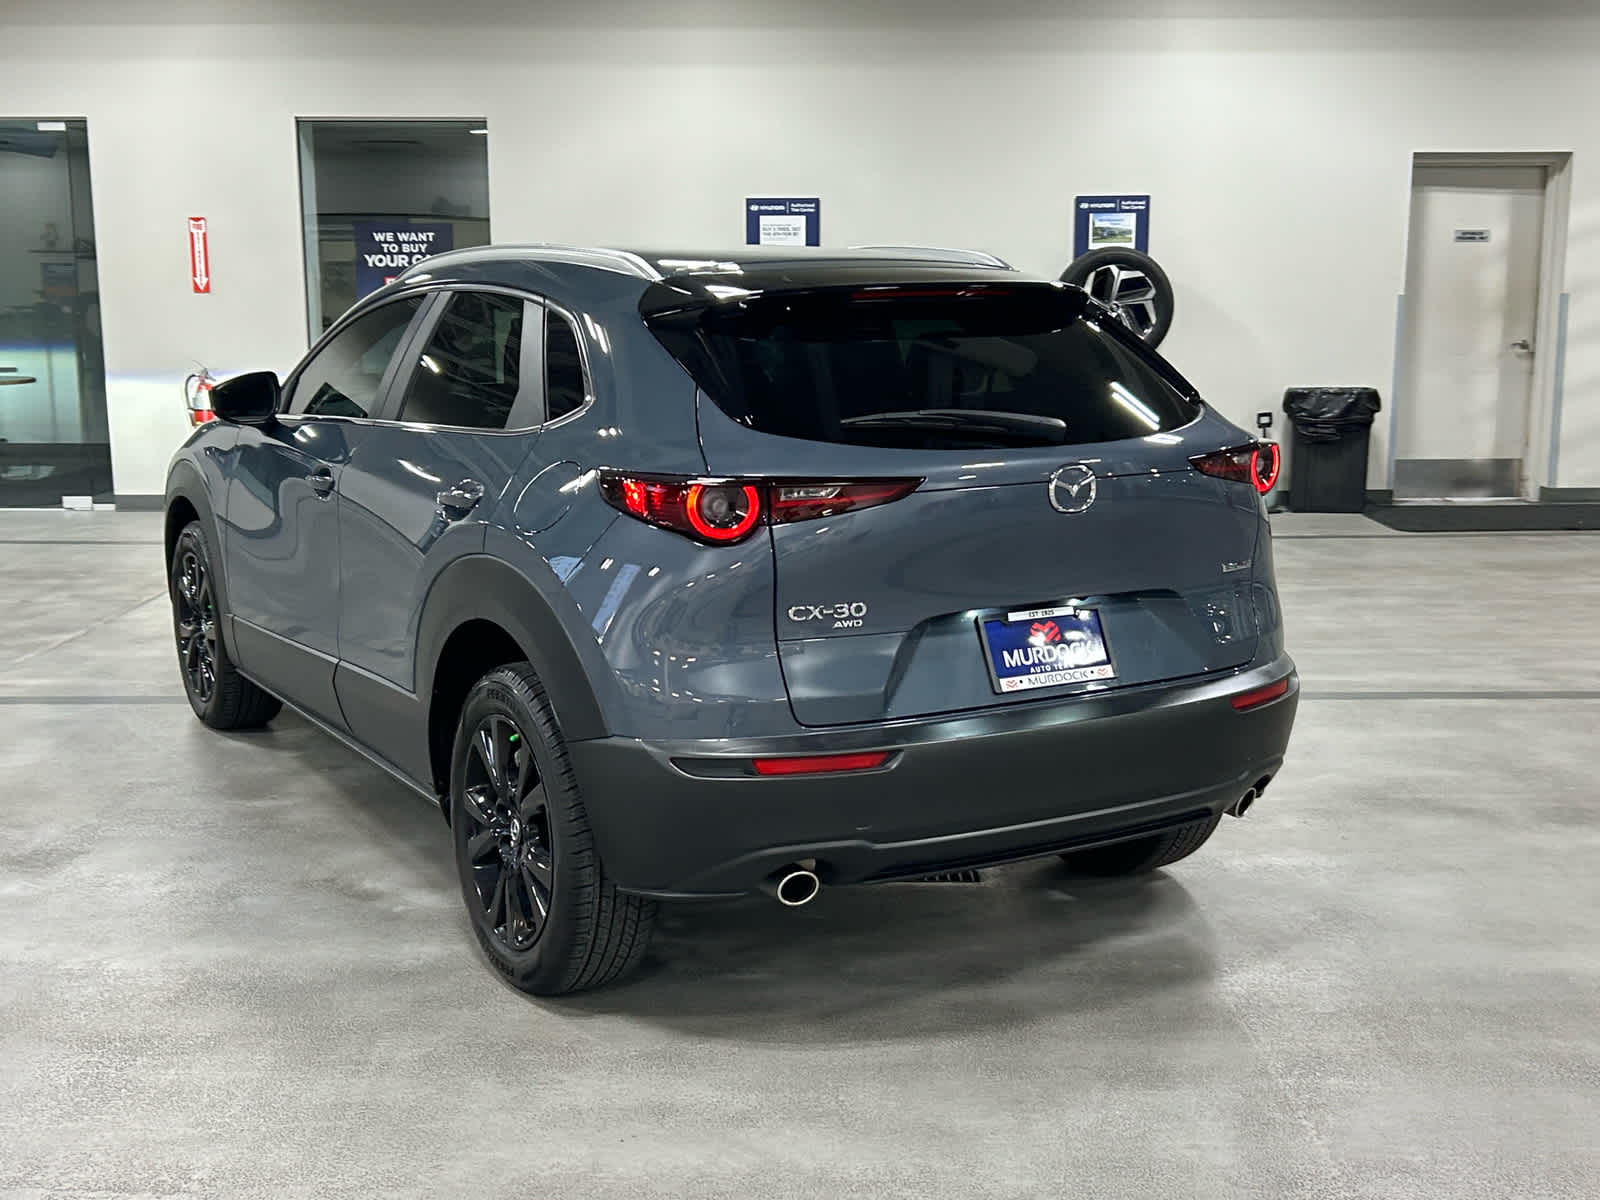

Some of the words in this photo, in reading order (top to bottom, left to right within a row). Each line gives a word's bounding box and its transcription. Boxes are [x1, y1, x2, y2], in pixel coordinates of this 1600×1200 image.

[372, 232, 395, 242] WE
[396, 232, 435, 242] WANT
[381, 243, 399, 253] TO
[402, 243, 428, 253] BUY
[363, 254, 409, 267] YOUR
[788, 602, 867, 621] CX-30
[832, 619, 863, 629] AWD
[1030, 663, 1051, 673] AUTO
[1028, 670, 1089, 685] MURDOCK
